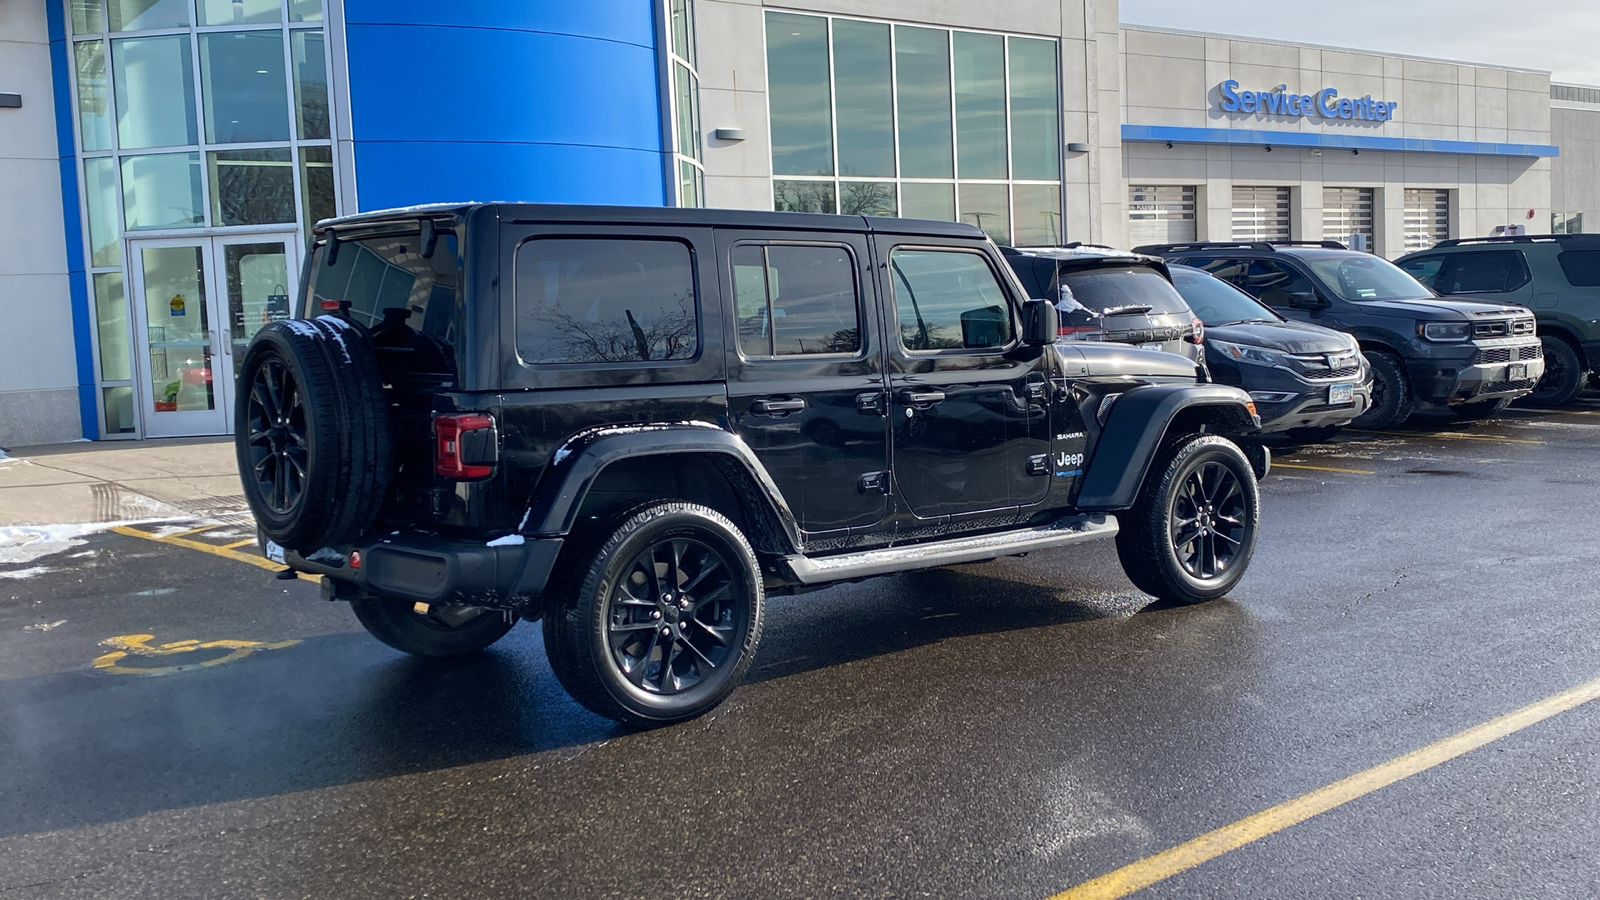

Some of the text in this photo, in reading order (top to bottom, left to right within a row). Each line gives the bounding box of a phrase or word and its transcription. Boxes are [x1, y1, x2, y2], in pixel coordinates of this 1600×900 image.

[1220, 79, 1398, 121] Service Center
[1056, 432, 1084, 440] SAHARA
[1057, 451, 1084, 467] Jeep
